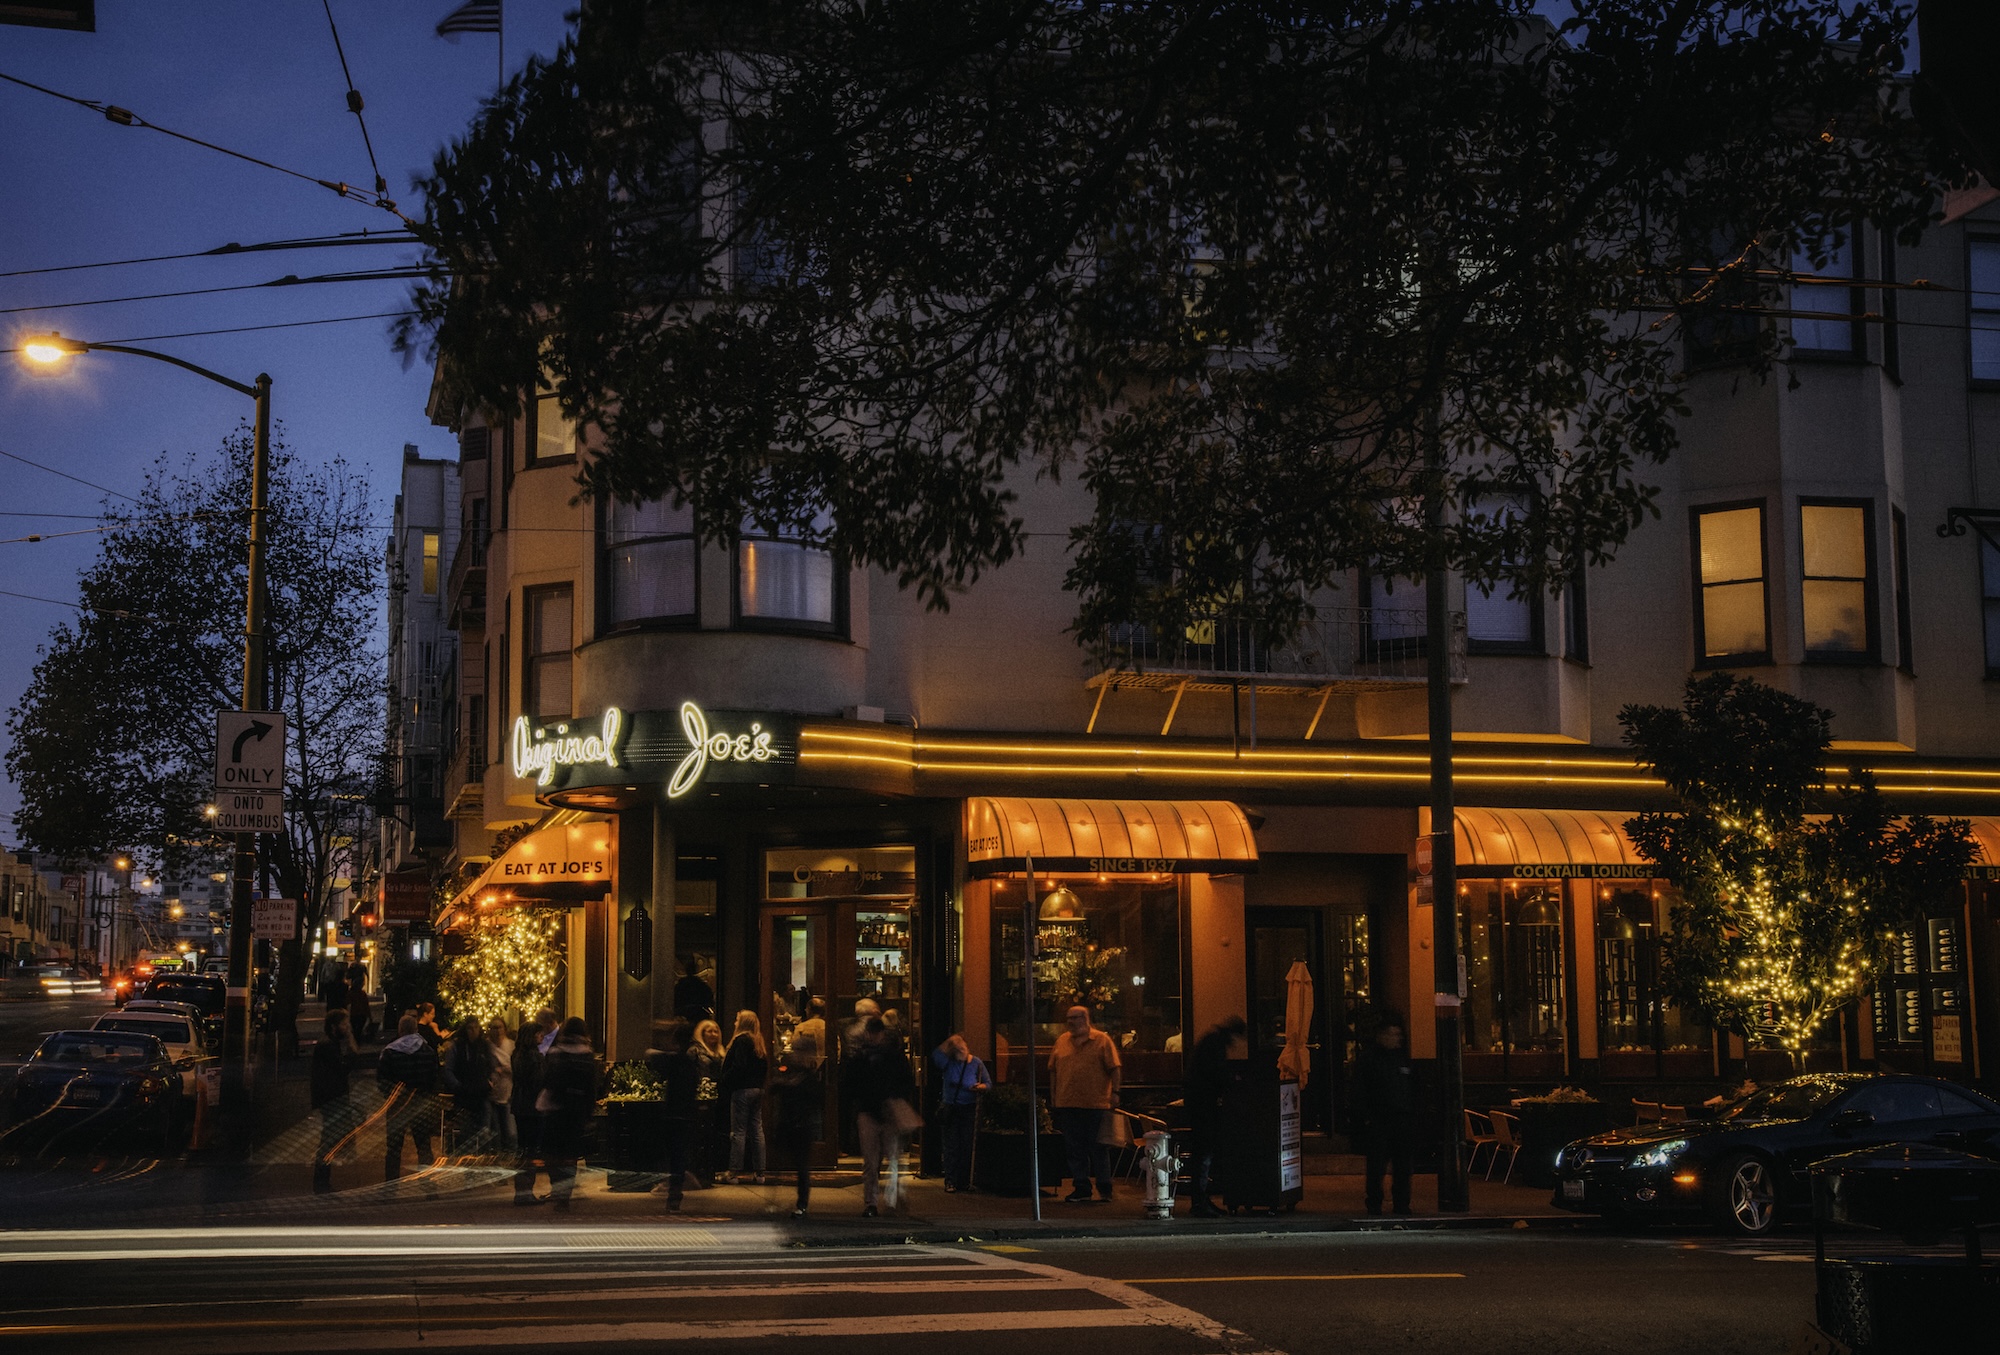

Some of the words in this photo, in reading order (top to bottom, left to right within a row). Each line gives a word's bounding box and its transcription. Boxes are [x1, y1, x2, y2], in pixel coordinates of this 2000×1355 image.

[513, 707, 622, 786] Original
[225, 767, 274, 783] ONLY
[234, 795, 264, 810] ONTO
[217, 813, 279, 829] COLUMBUS
[505, 862, 532, 876] EAT
[537, 861, 557, 875] AT
[560, 860, 603, 874] JOE'S
[1089, 858, 1136, 872] SINCE
[1141, 859, 1178, 873] 1937
[1513, 865, 1585, 878] COCKTAIL
[1591, 865, 1654, 878] LOUNGE
[269, 902, 294, 911] PARKING
